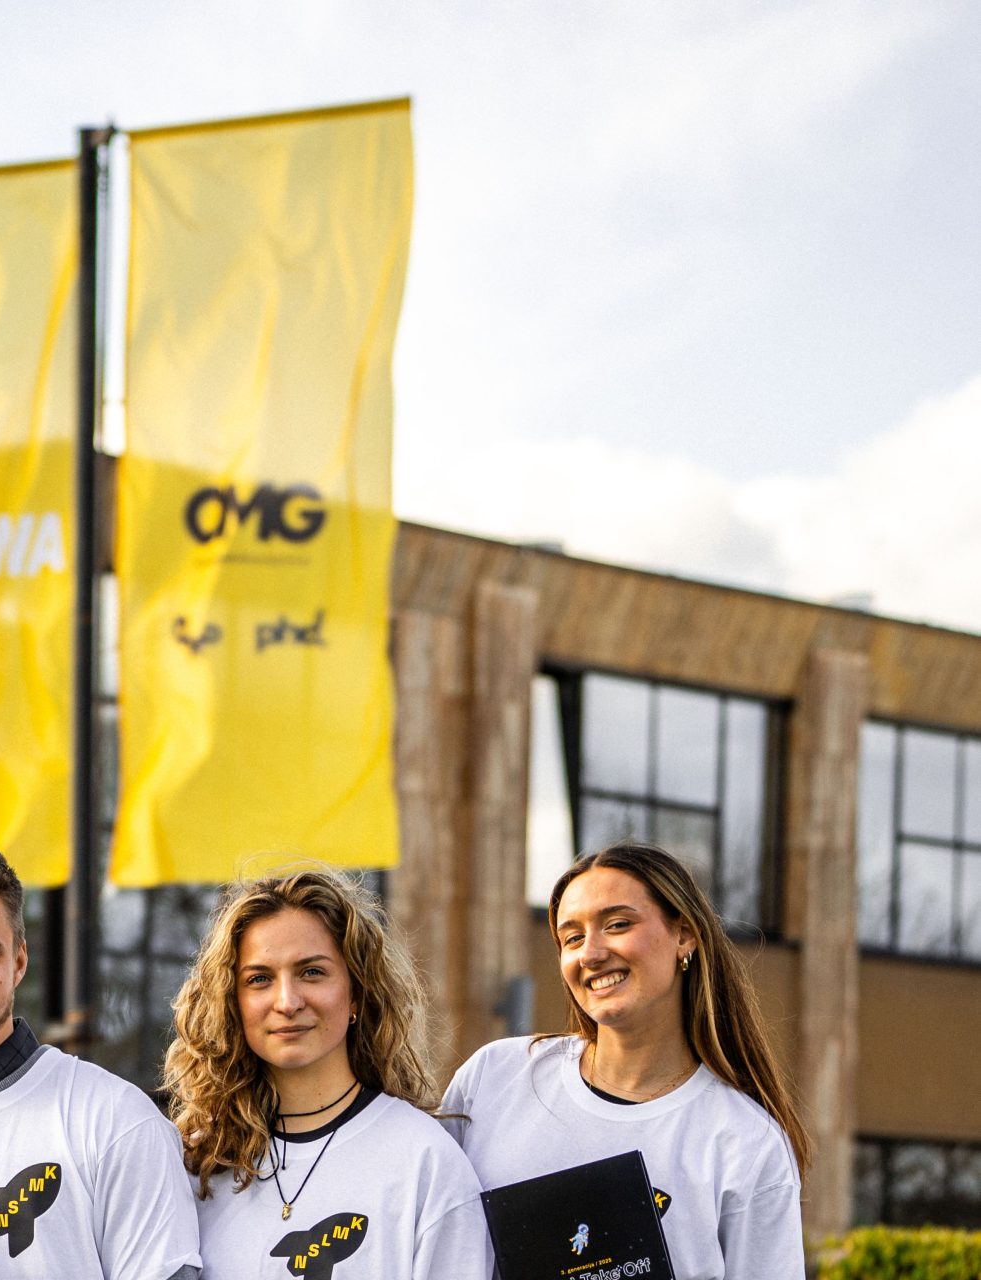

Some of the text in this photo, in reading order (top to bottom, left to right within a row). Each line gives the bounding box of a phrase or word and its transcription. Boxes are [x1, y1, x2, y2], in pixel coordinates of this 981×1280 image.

[185, 483, 326, 543] OMG
[294, 1216, 364, 1269] NSLMK
[622, 1257, 651, 1277] Off
